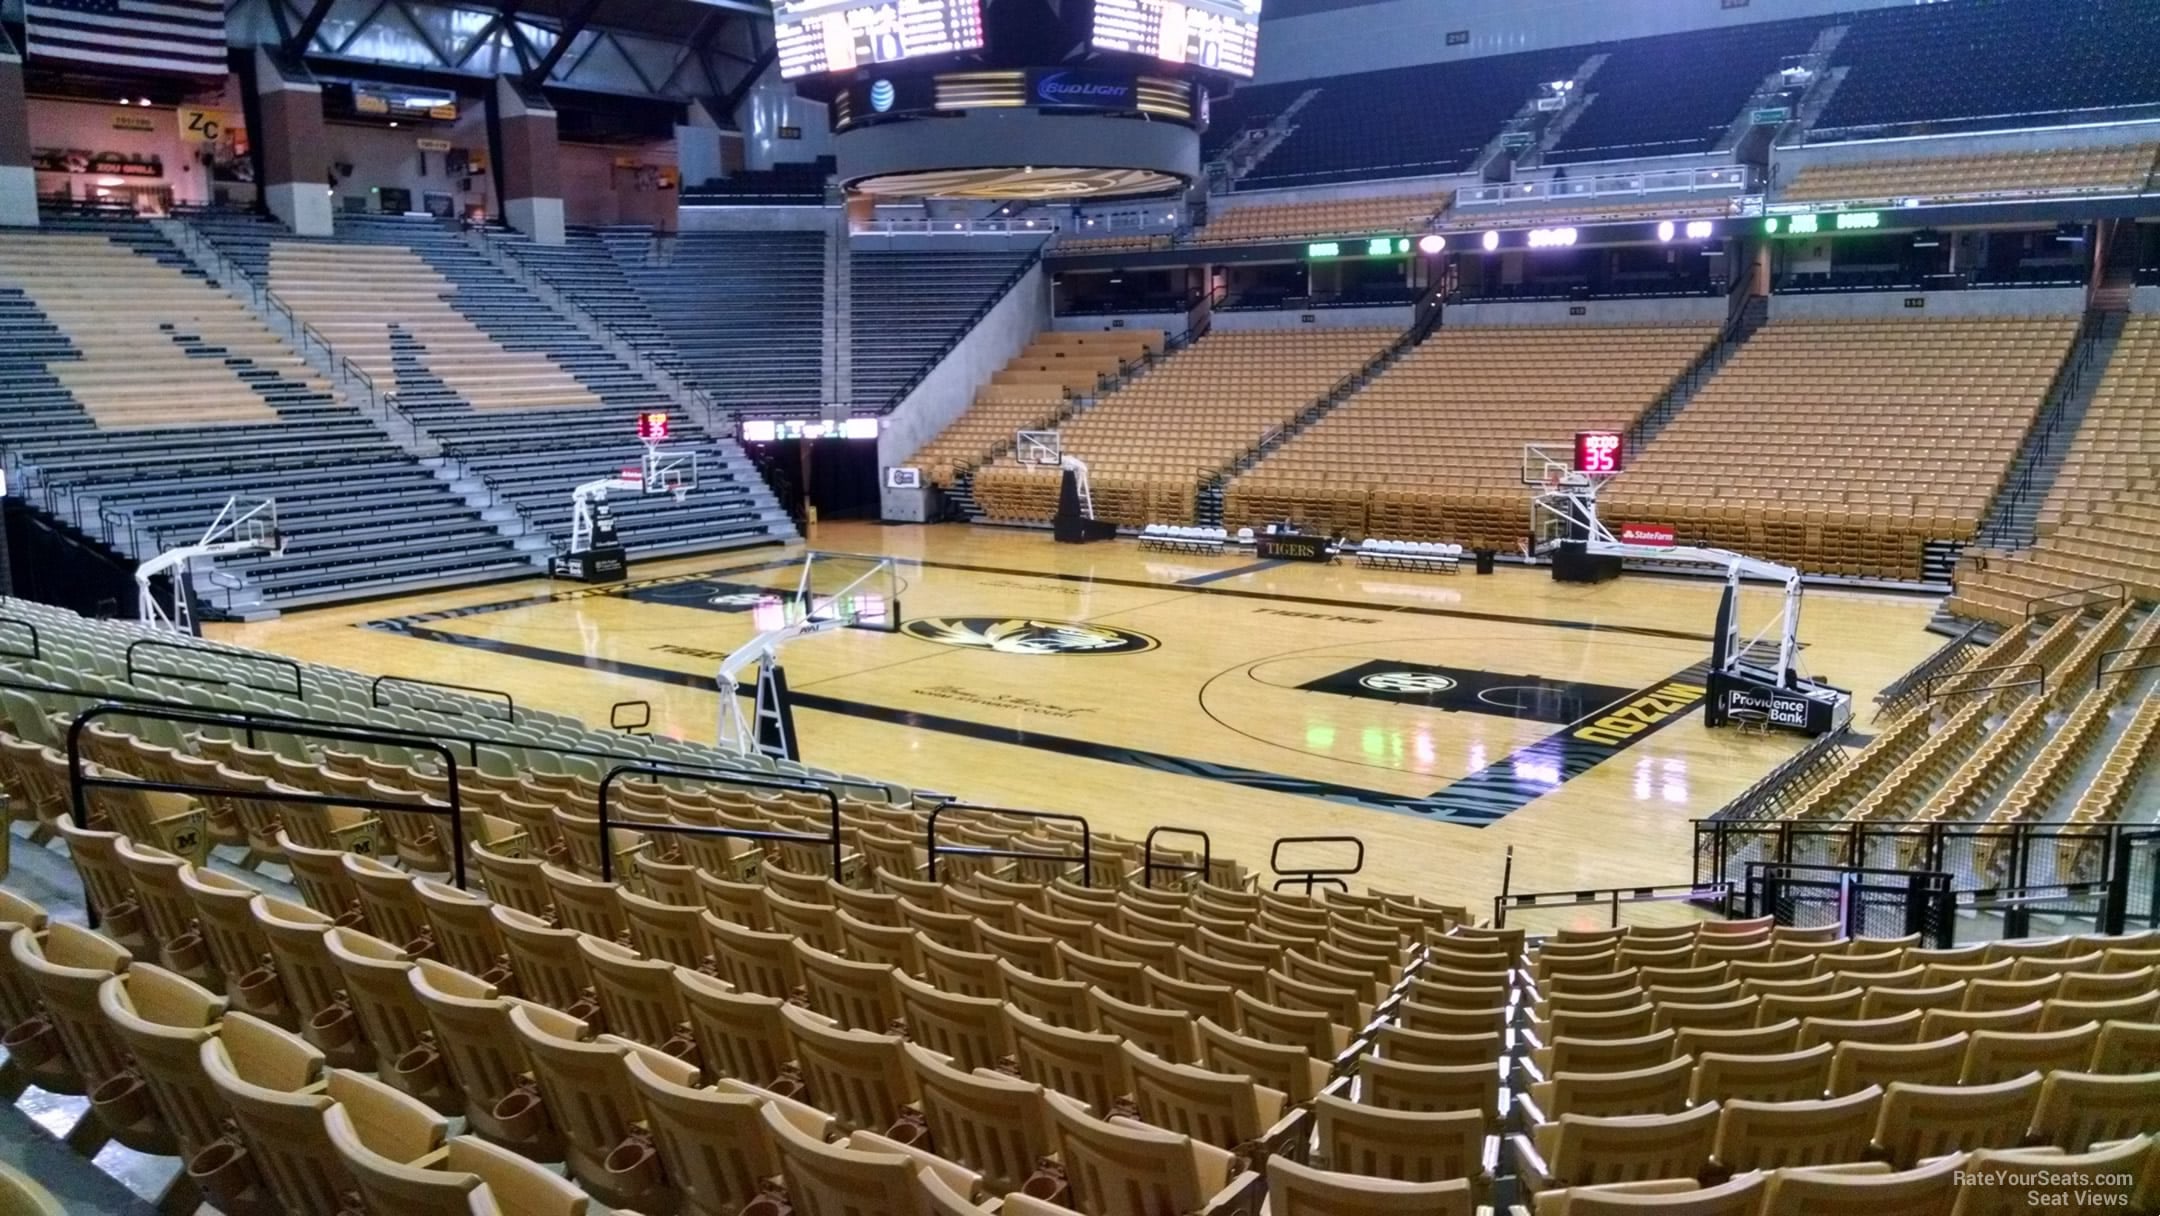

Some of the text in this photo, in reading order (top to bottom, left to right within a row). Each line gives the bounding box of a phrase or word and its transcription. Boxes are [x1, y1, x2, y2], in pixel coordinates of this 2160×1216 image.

[1082, 84, 1128, 96] LIGHT
[1585, 448, 1614, 470] 35
[1266, 542, 1315, 557] TIGERS
[1573, 682, 1707, 746] MIZZOU
[1770, 709, 1803, 724] Bank
